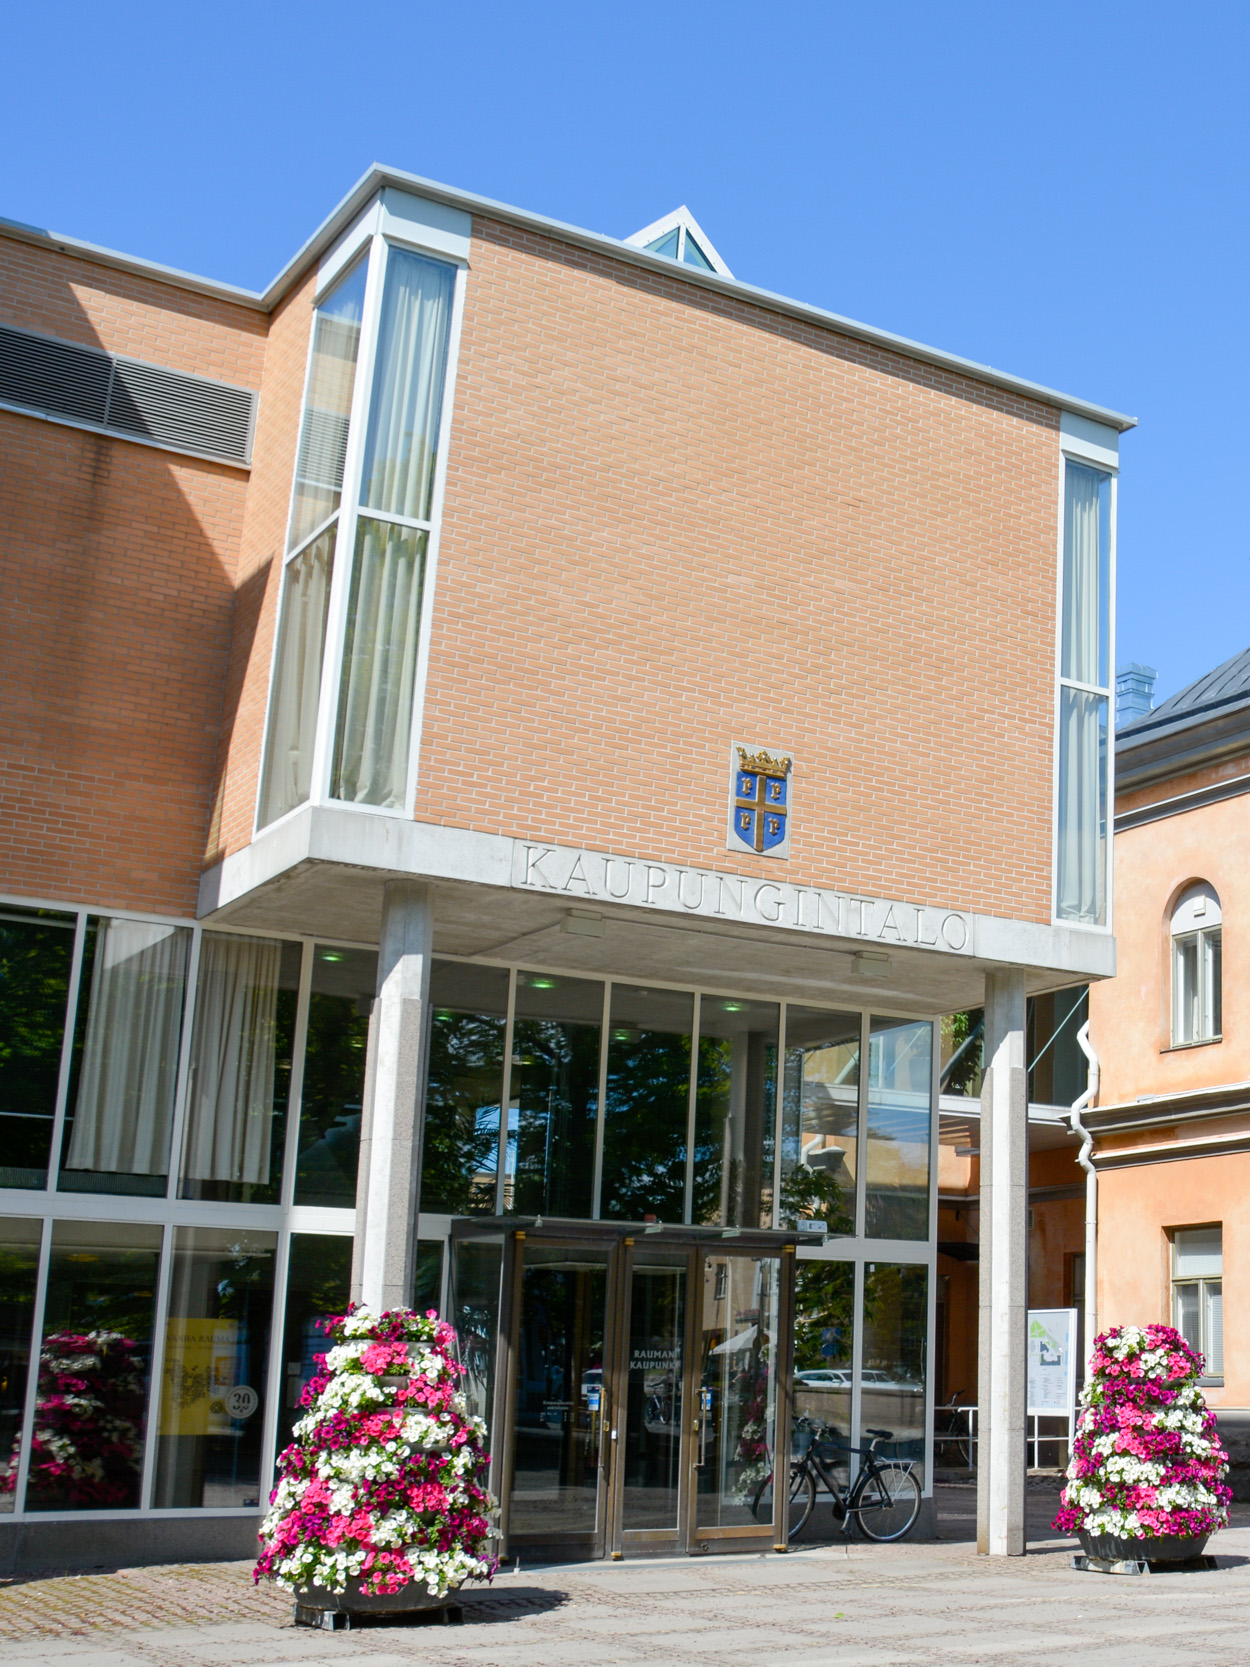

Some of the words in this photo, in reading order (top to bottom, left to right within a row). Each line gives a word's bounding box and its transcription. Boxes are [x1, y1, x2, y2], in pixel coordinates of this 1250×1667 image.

[520, 844, 970, 951] KAUPUNGINTALO
[634, 1350, 676, 1358] RAUMAN
[233, 1393, 250, 1410] 30
